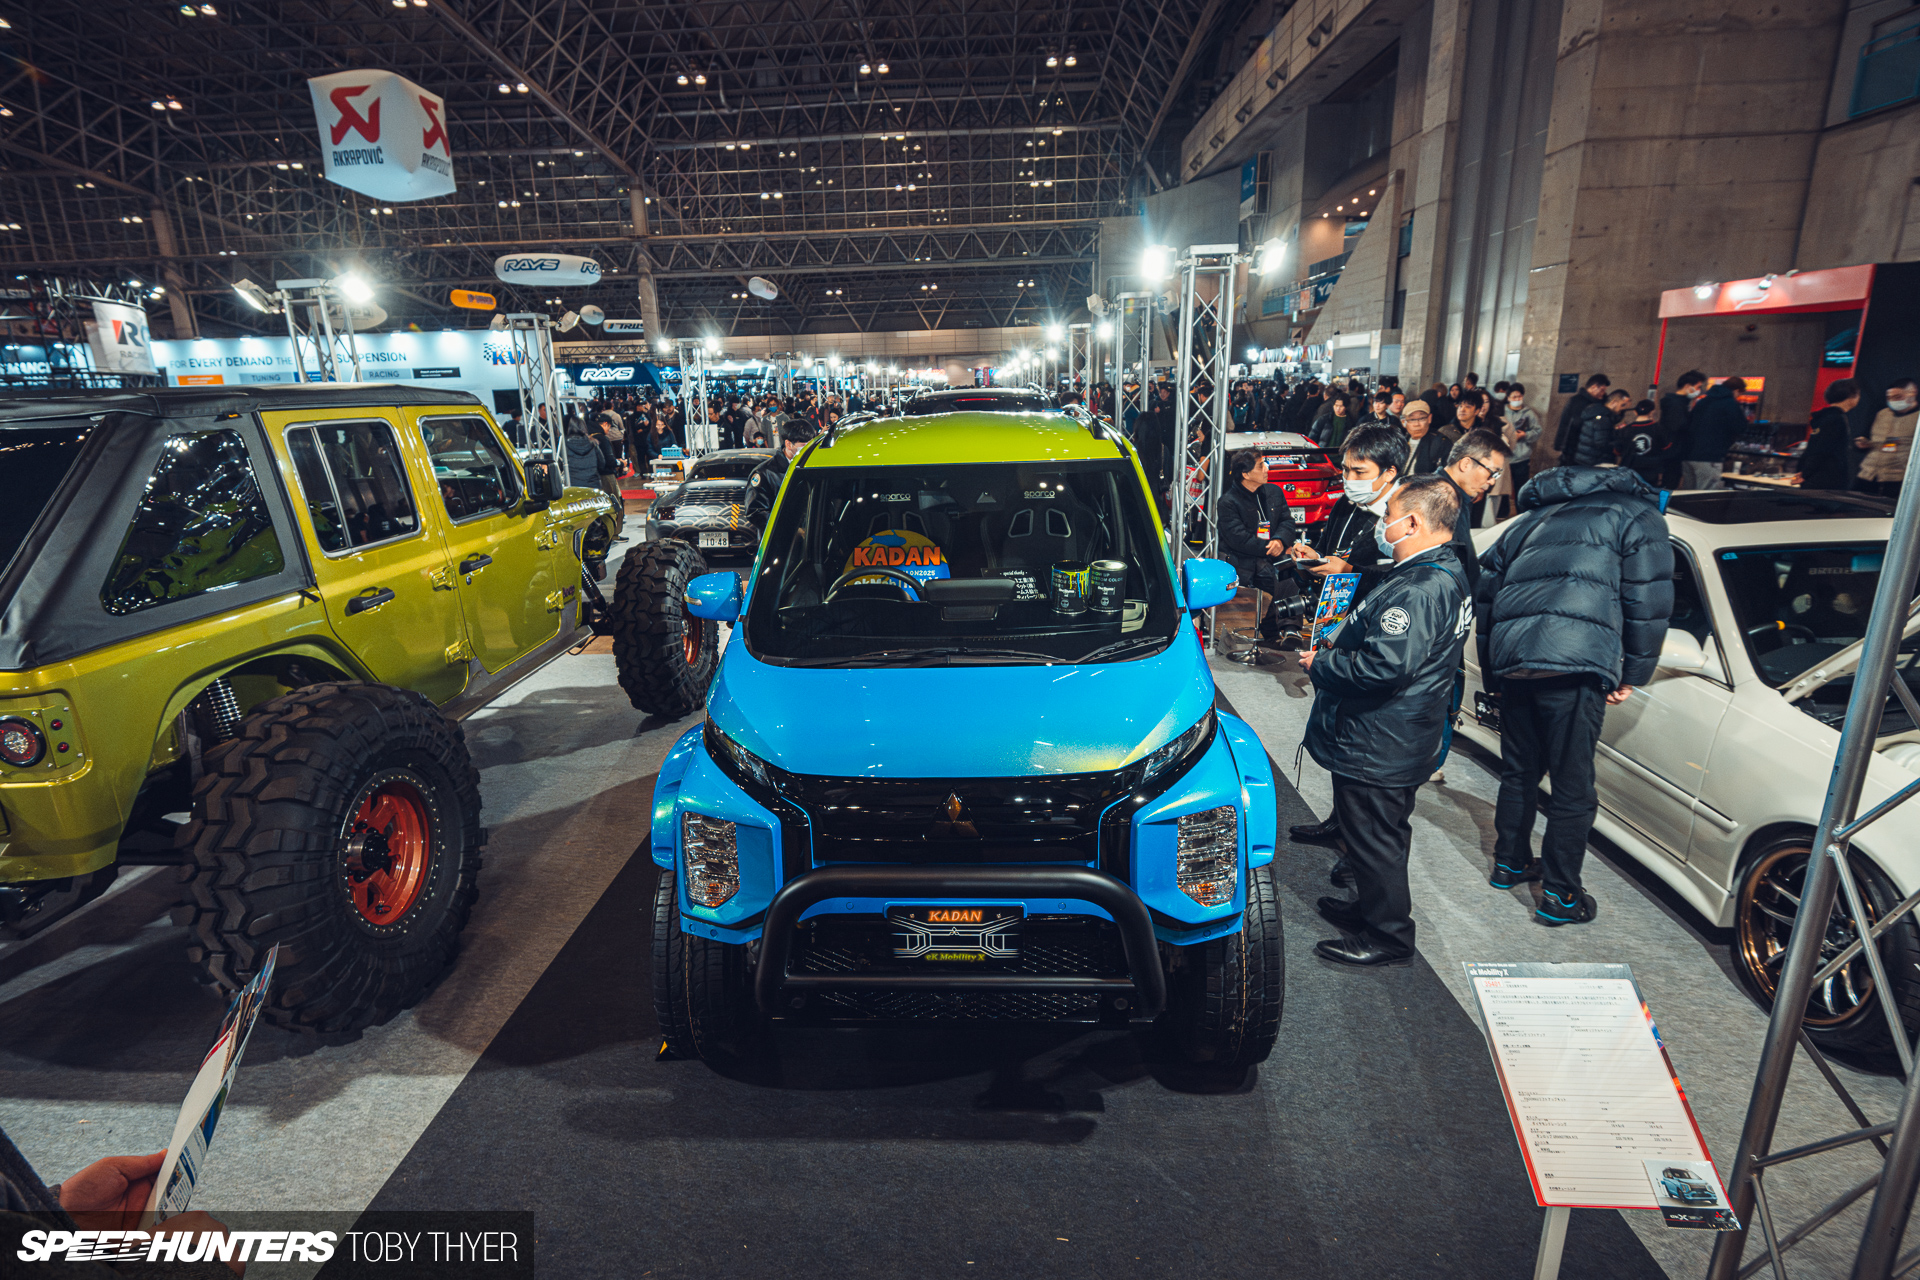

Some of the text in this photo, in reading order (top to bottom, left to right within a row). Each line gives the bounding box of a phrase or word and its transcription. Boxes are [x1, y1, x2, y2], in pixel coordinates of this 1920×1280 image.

[332, 146, 384, 167] AKRAPOVIČ
[504, 258, 560, 272] RAYS
[170, 360, 187, 368] FOR
[188, 358, 222, 367] EVERY
[226, 356, 273, 366] DEMAND
[276, 356, 293, 365] THE
[337, 351, 407, 363] SUPENSION
[369, 370, 399, 378] RACING
[580, 366, 635, 382] RAYS
[1024, 490, 1056, 499] sparco
[853, 546, 941, 567] KADAN
[928, 909, 983, 922] KADAN
[939, 953, 976, 962] Mobility
[976, 953, 986, 961] X
[1477, 968, 1504, 977] Mobility
[1503, 968, 1510, 976] X
